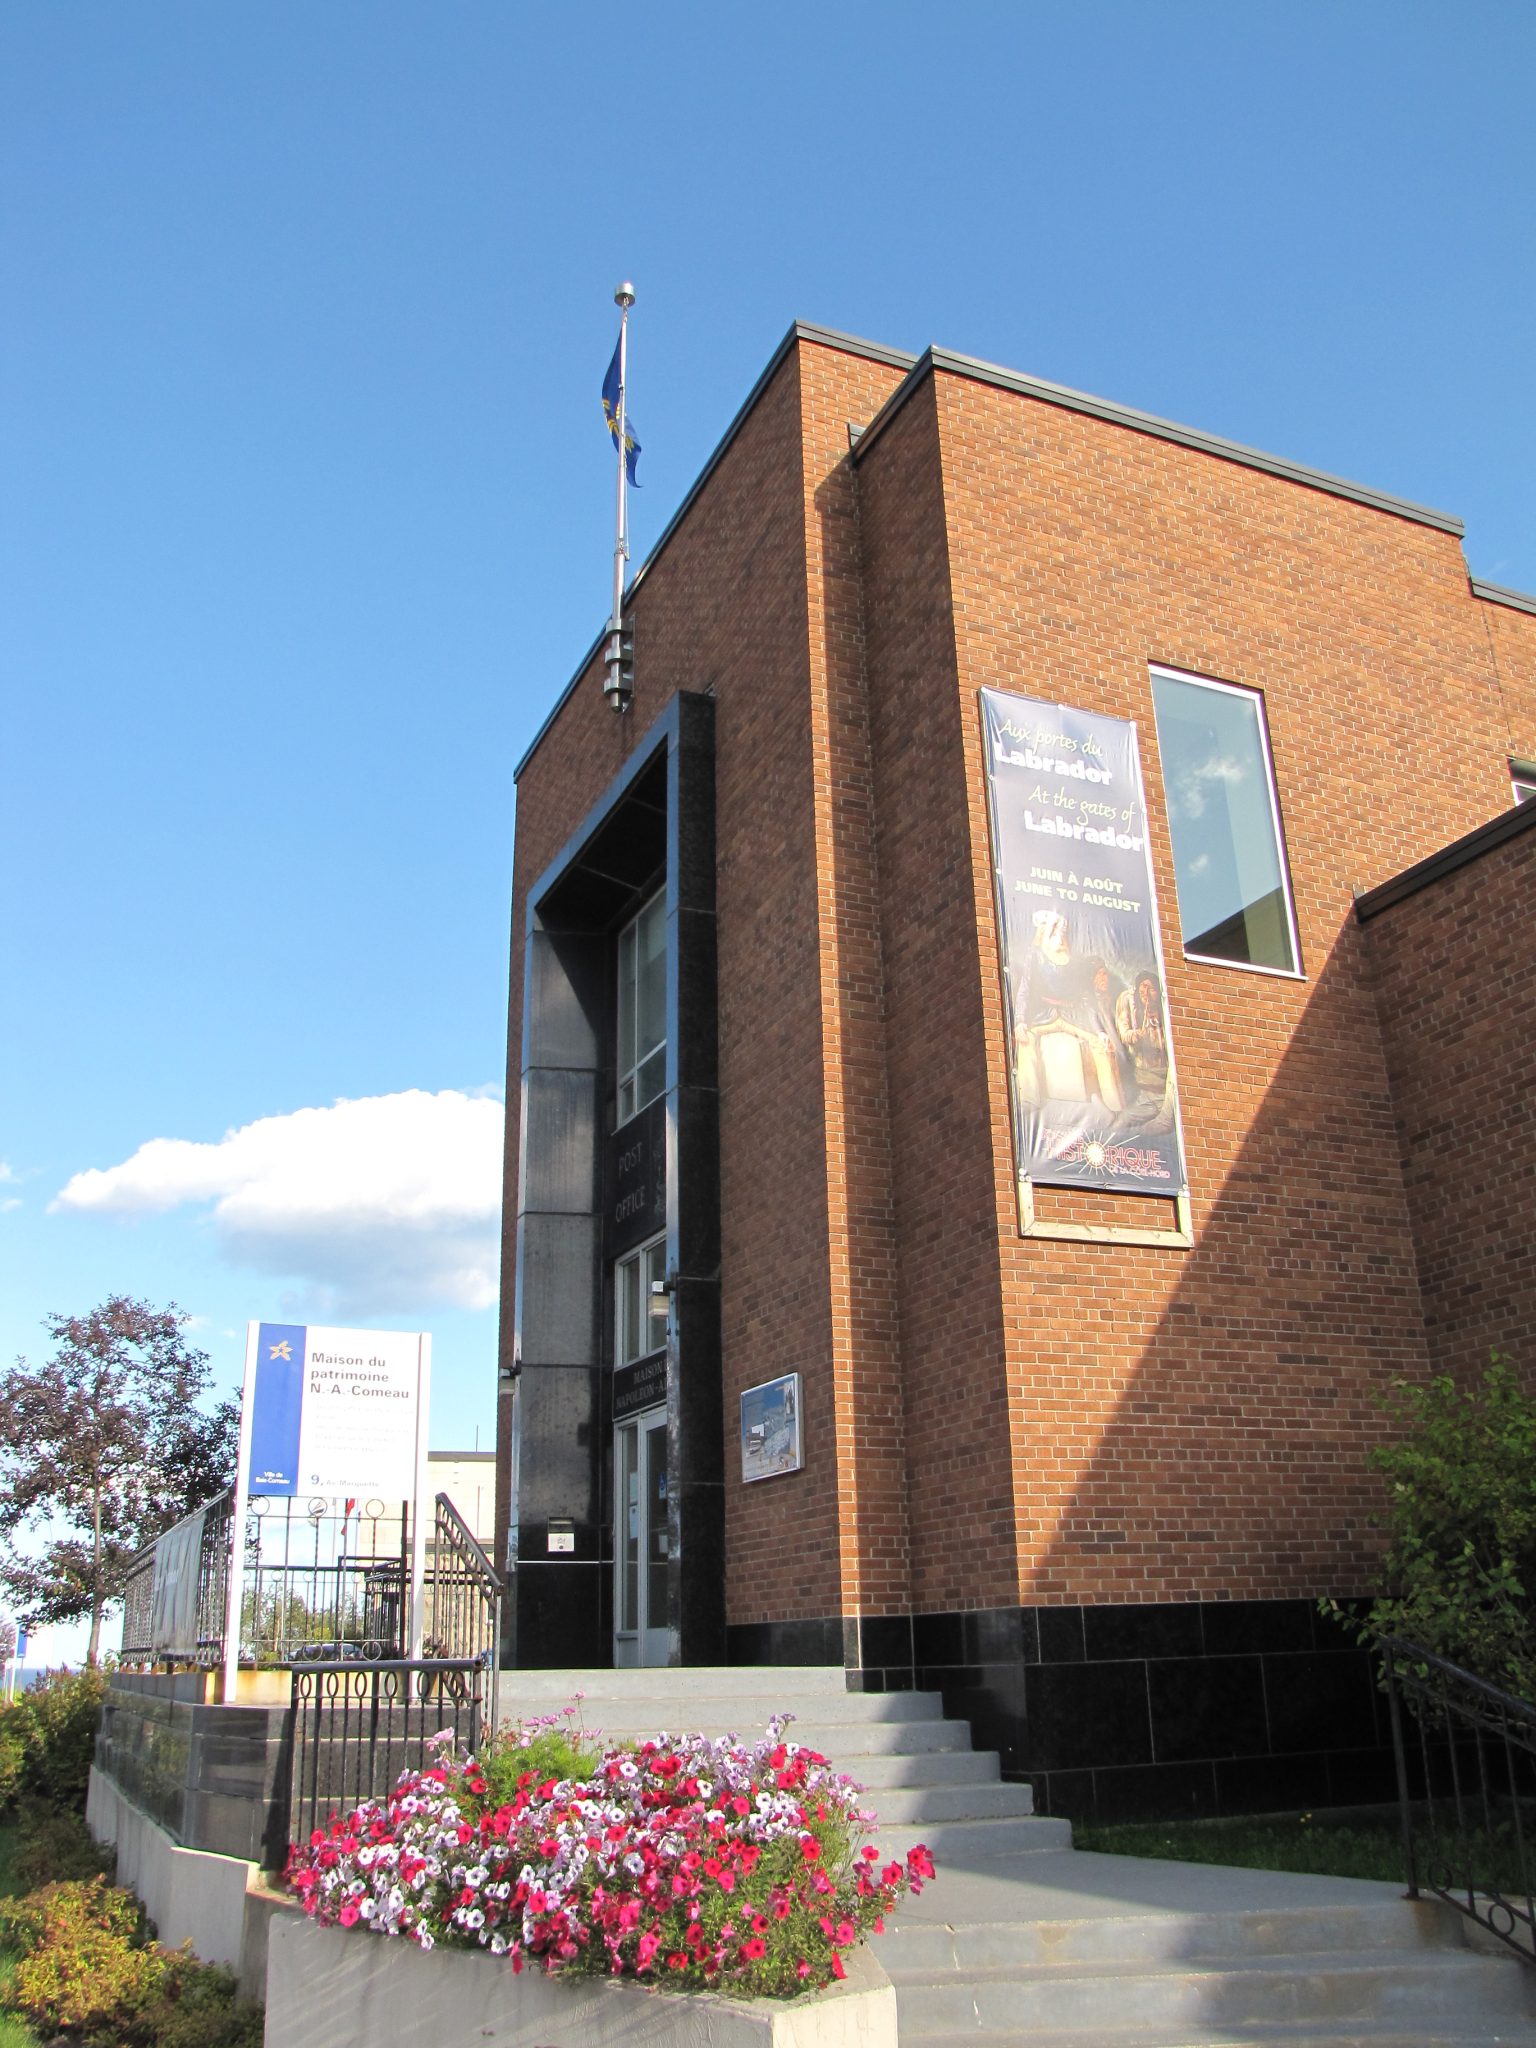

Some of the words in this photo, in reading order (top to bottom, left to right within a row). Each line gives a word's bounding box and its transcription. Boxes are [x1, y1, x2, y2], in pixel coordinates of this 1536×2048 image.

[1000, 719, 1032, 743] Aux
[1033, 727, 1078, 754] portes
[1082, 734, 1104, 757] du
[994, 743, 1112, 785] Labrador
[1028, 785, 1050, 804] At
[1053, 787, 1077, 810] the
[1076, 799, 1116, 826] gates
[1121, 802, 1136, 833] of
[1024, 810, 1143, 851] Labrador
[1014, 880, 1053, 897] JUNE
[1057, 887, 1077, 901] TO
[1082, 894, 1140, 913] AUGUST
[1029, 866, 1063, 883] JUIN
[1068, 871, 1079, 886] À
[1083, 876, 1123, 894] AOÛT
[618, 1141, 642, 1179] POST
[615, 1185, 645, 1223] OFFICE
[311, 1352, 363, 1366] Maison
[369, 1356, 386, 1368] du
[311, 1369, 389, 1383] patrimoine
[633, 1360, 663, 1384] MAISON
[310, 1383, 409, 1399] N.-A.-Comeau
